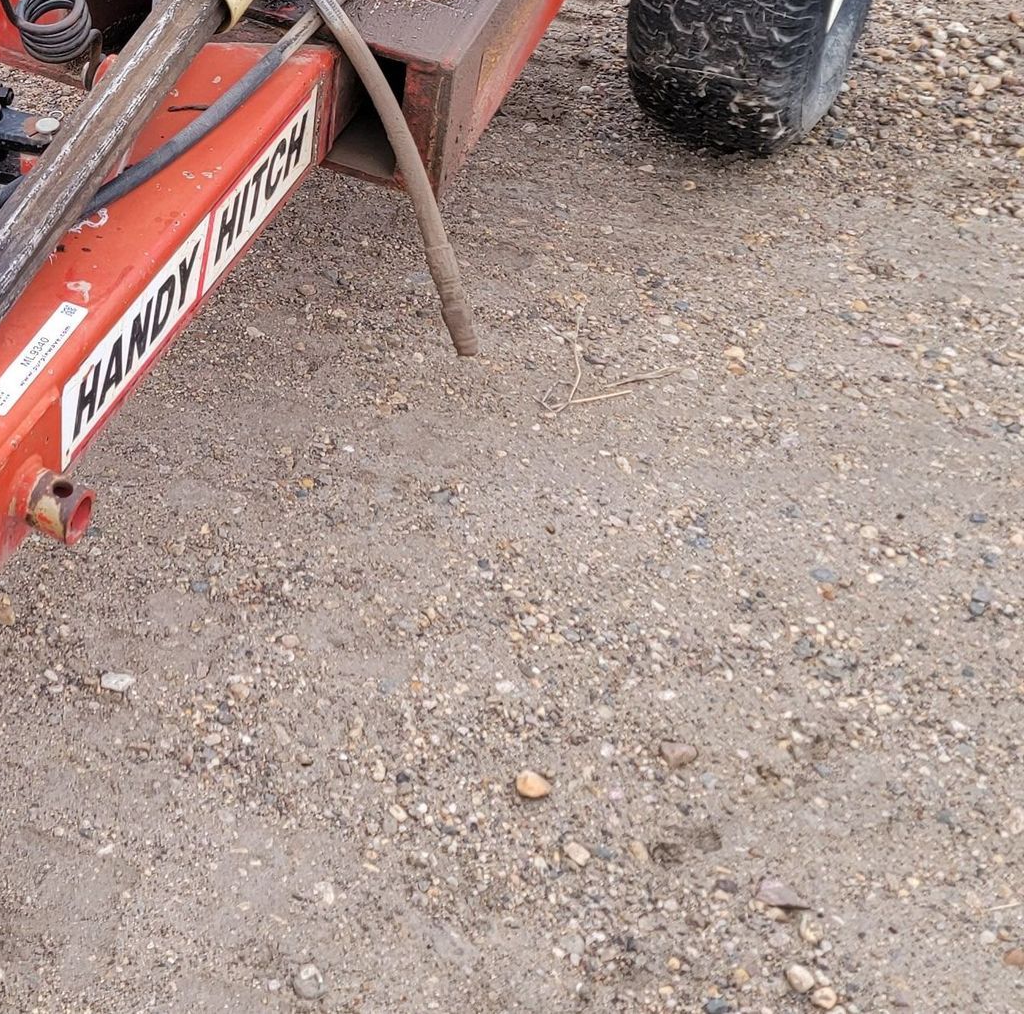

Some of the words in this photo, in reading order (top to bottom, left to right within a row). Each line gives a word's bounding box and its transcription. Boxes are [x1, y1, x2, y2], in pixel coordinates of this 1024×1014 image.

[20, 336, 50, 367] ML9340
[72, 241, 201, 443] HANDY
[214, 112, 309, 266] HITCH
